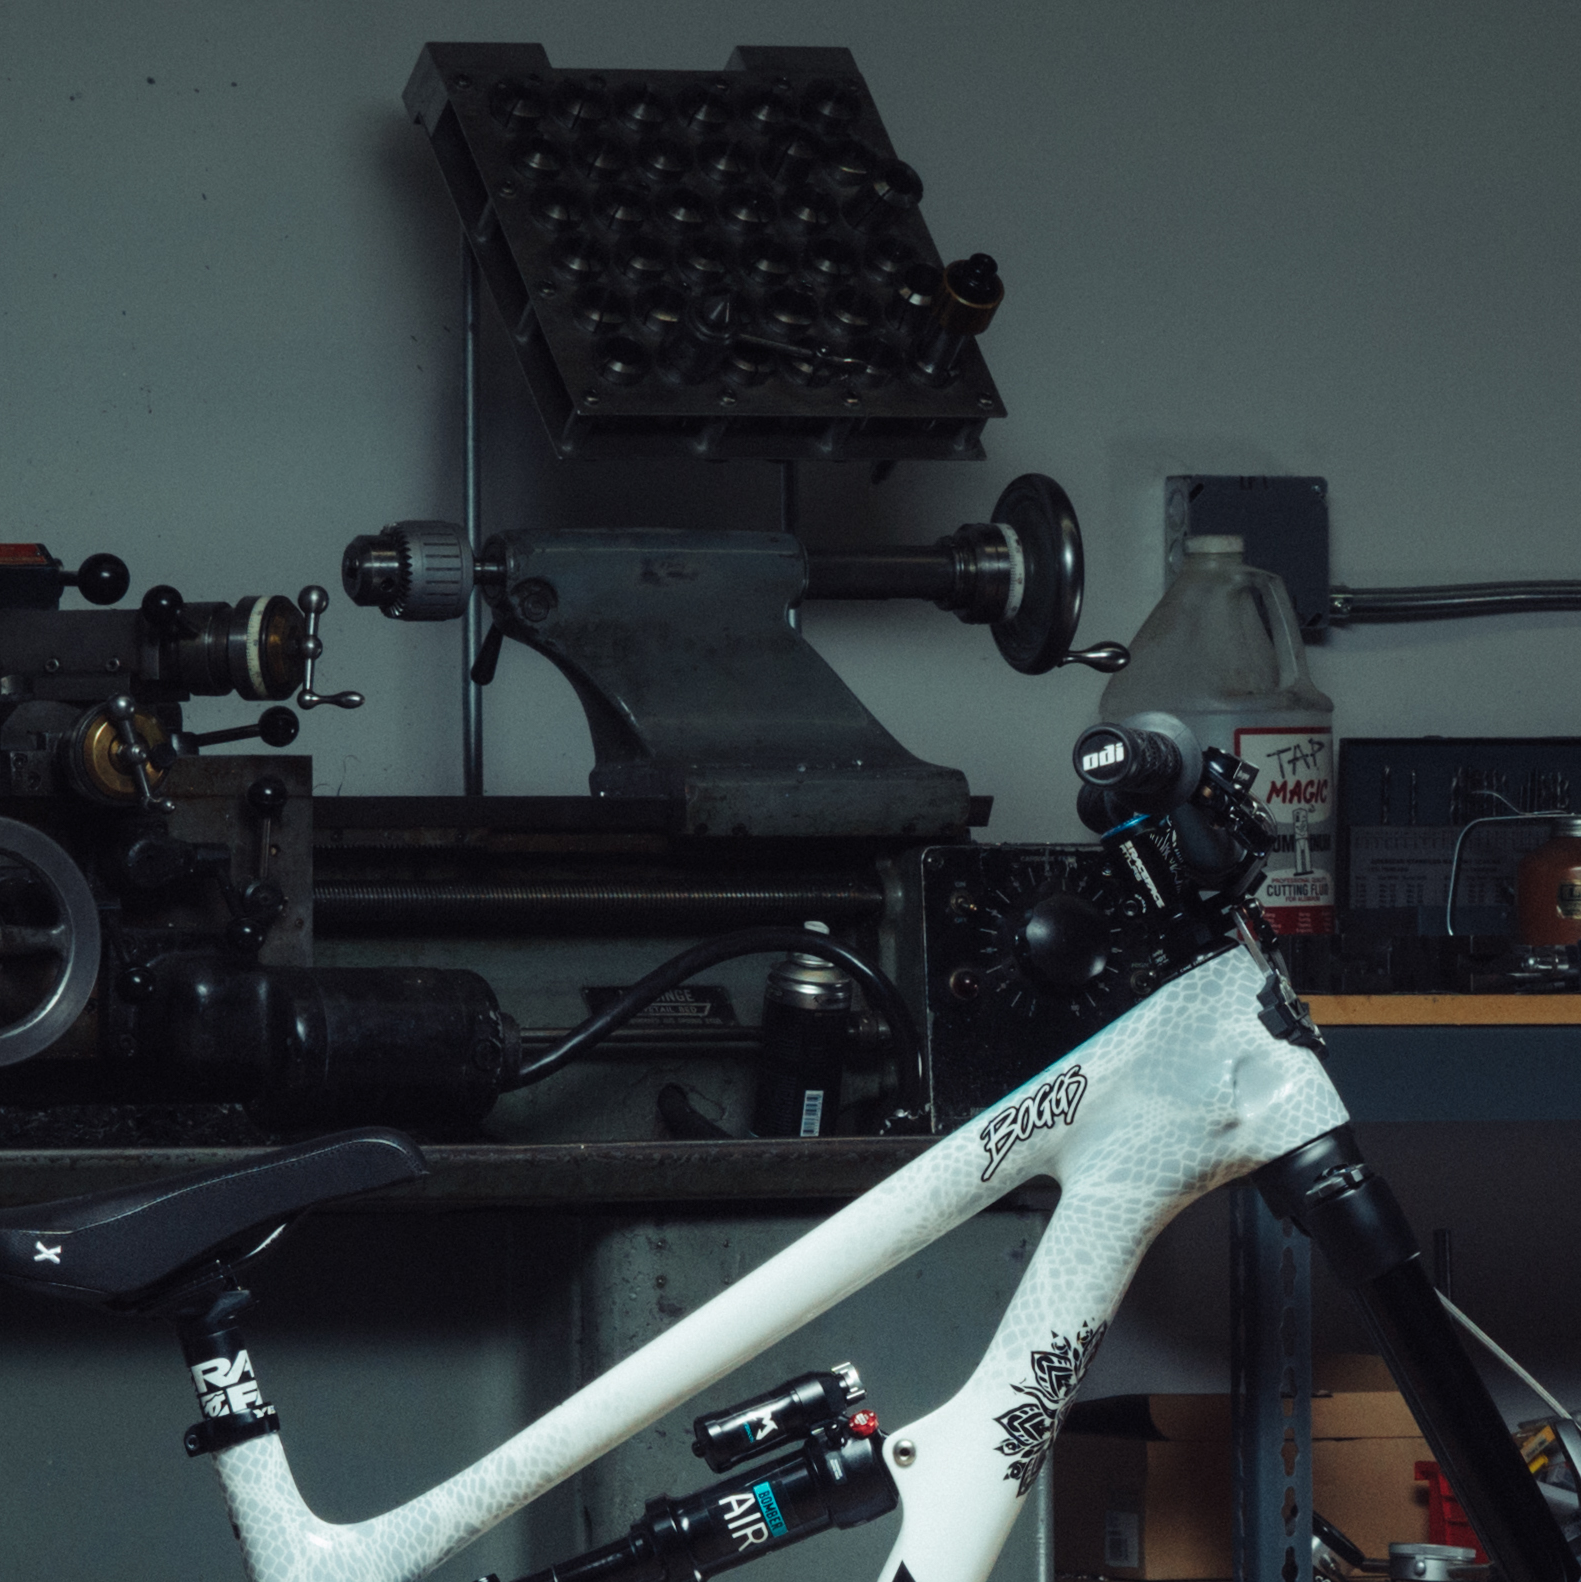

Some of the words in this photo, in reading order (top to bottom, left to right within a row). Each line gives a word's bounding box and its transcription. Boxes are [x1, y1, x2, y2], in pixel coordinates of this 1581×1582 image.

[1082, 742, 1126, 773] odi
[1266, 738, 1325, 779] TAP
[1266, 779, 1329, 804] MAGIC
[1266, 884, 1309, 897] CUTTING
[980, 1064, 1088, 1182] BOGGS
[719, 1492, 769, 1552] AIR
[758, 1490, 784, 1531] BOMBER
